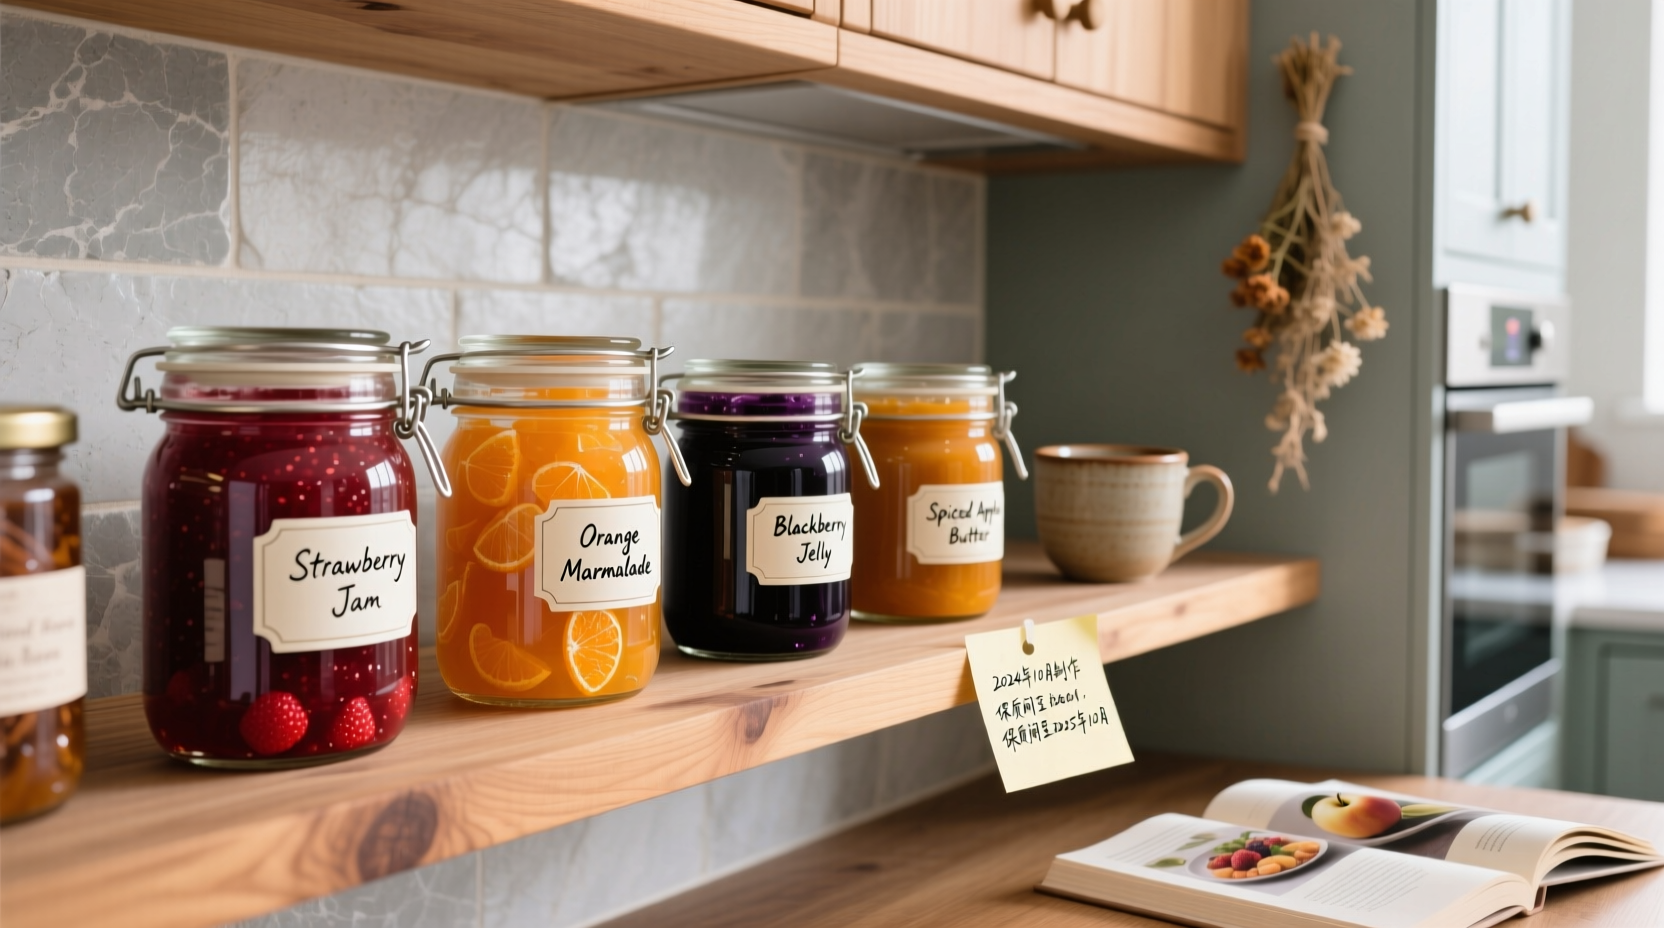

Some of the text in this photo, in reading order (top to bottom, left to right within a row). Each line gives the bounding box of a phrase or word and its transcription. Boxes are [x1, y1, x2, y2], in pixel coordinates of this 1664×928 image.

[773, 512, 846, 541] Blackberry
[926, 500, 973, 527] Spiced
[580, 523, 640, 556] Orange
[949, 526, 990, 545] Butter
[289, 546, 406, 582] Strawberry
[560, 553, 652, 582] Marmalade
[796, 541, 832, 569] Jelly
[332, 584, 382, 618] Jam
